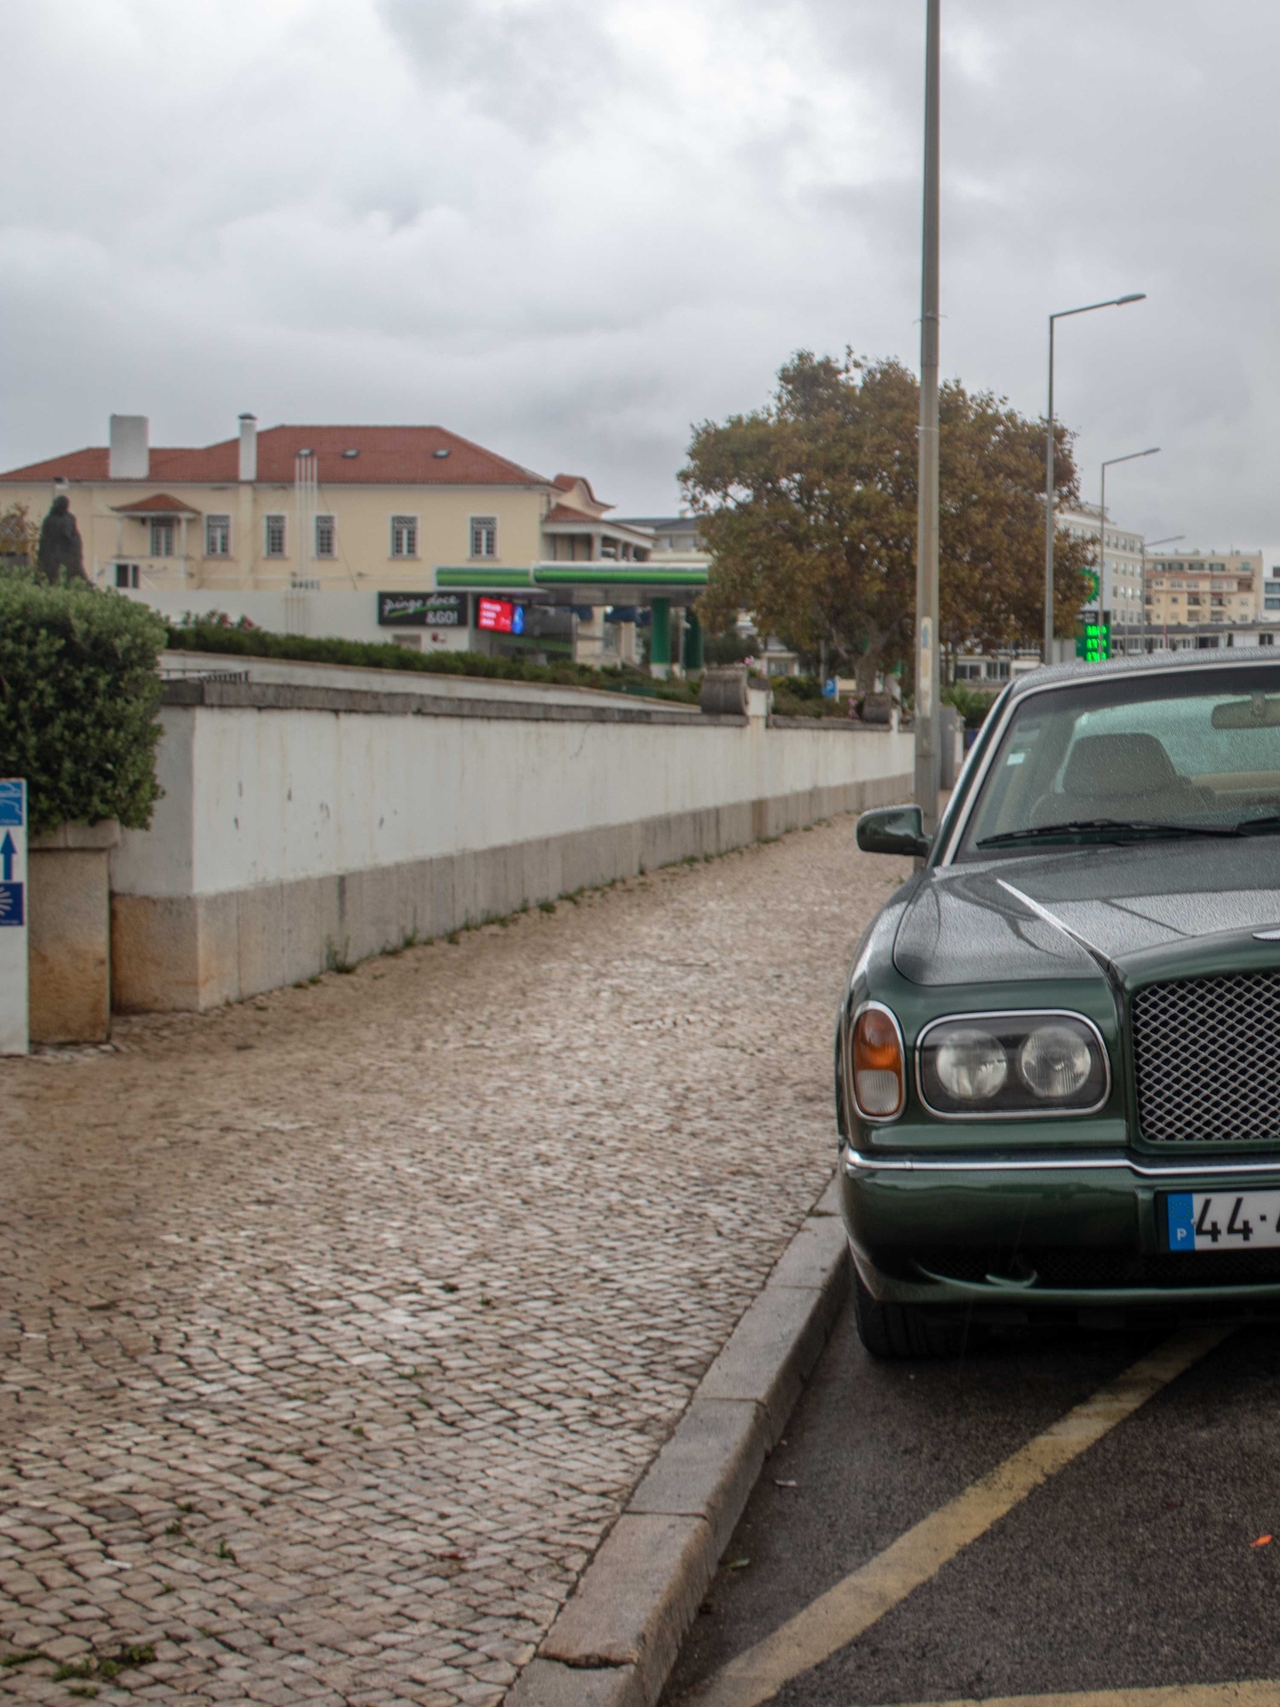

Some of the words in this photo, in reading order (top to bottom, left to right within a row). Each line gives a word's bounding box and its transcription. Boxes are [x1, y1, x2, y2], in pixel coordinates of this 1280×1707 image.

[383, 596, 423, 617] pingo
[426, 611, 458, 624] &GO!
[1176, 1228, 1187, 1241] P
